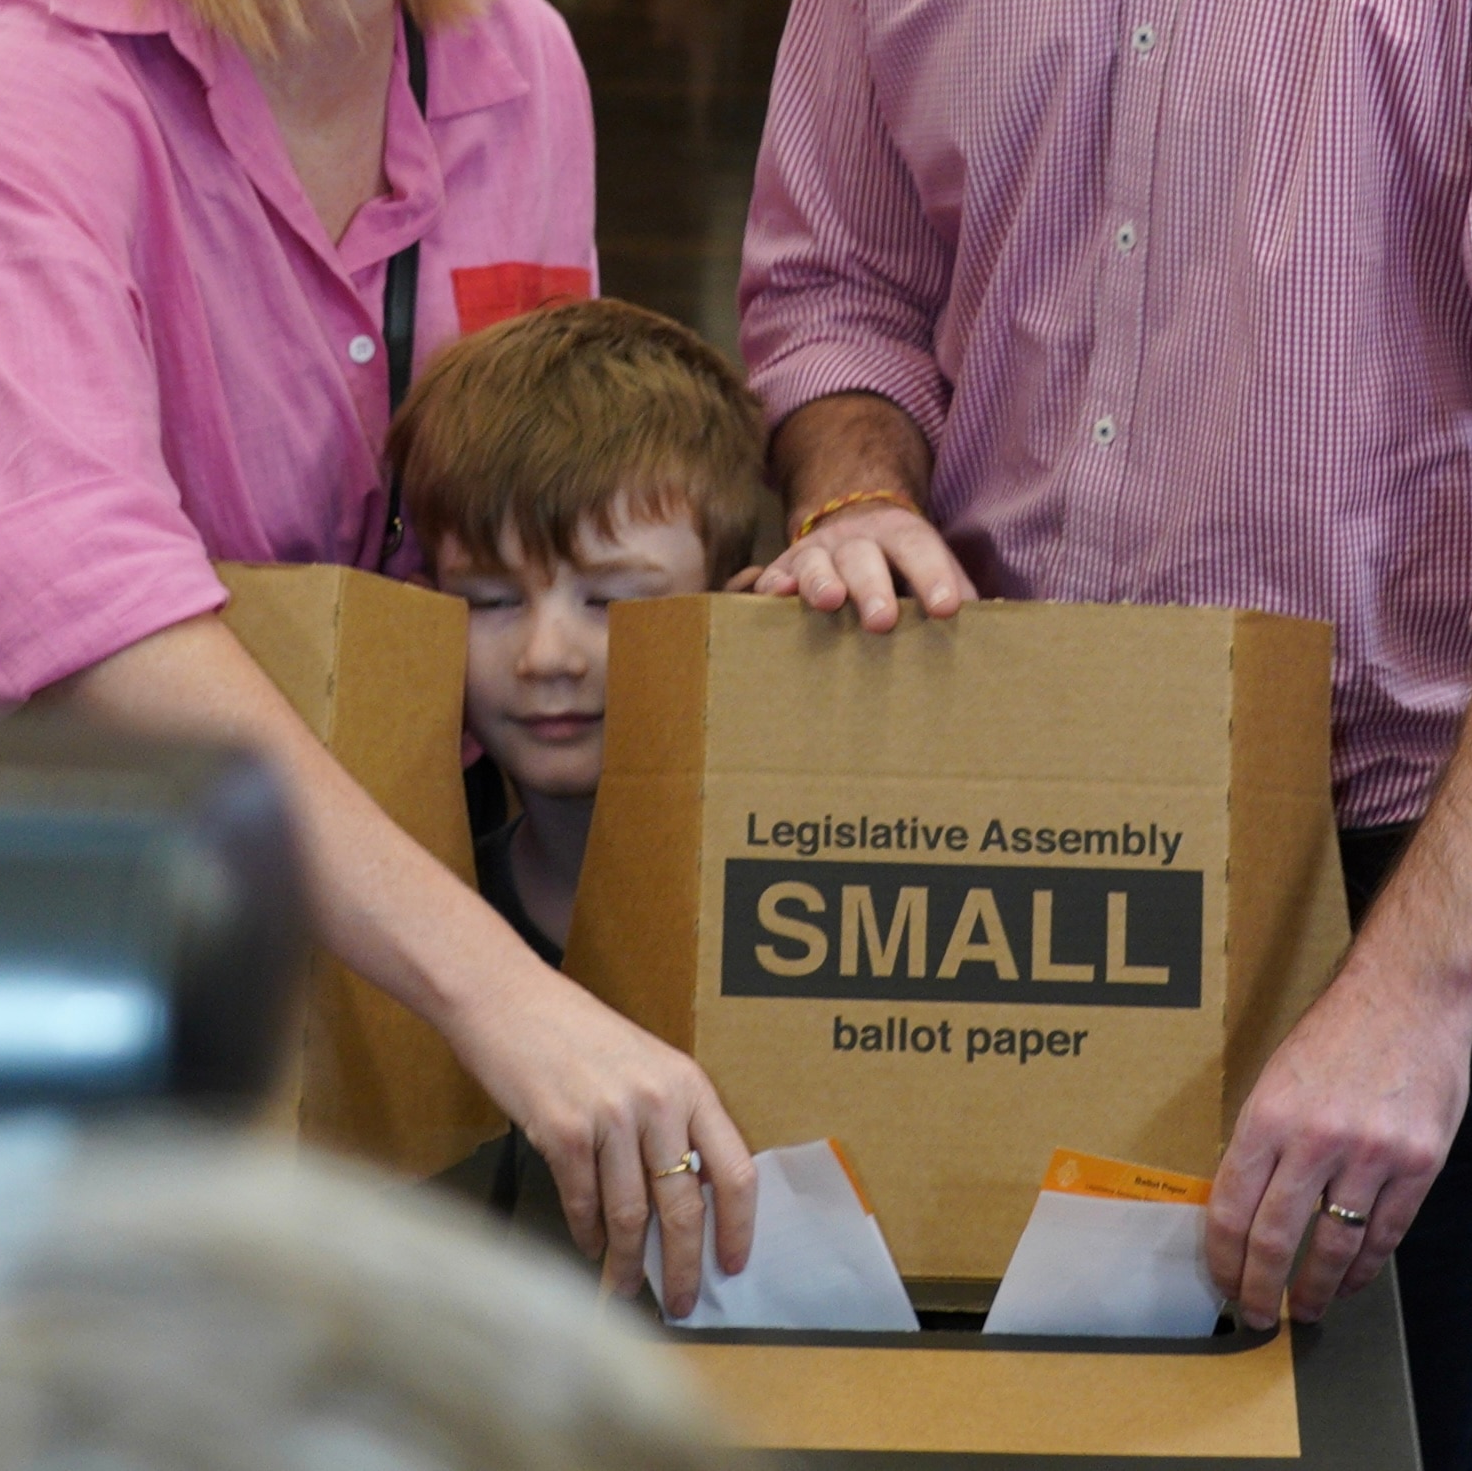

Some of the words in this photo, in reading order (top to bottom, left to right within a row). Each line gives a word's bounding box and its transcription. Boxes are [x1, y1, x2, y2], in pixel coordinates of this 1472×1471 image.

[747, 812, 969, 857] Legislative
[979, 819, 1183, 865] Assembly
[754, 880, 1170, 985] SMALL
[832, 1015, 953, 1053] ballot
[966, 1024, 1089, 1065] paper
[1134, 1176, 1161, 1189] Ballot
[1162, 1182, 1188, 1195] Paper
